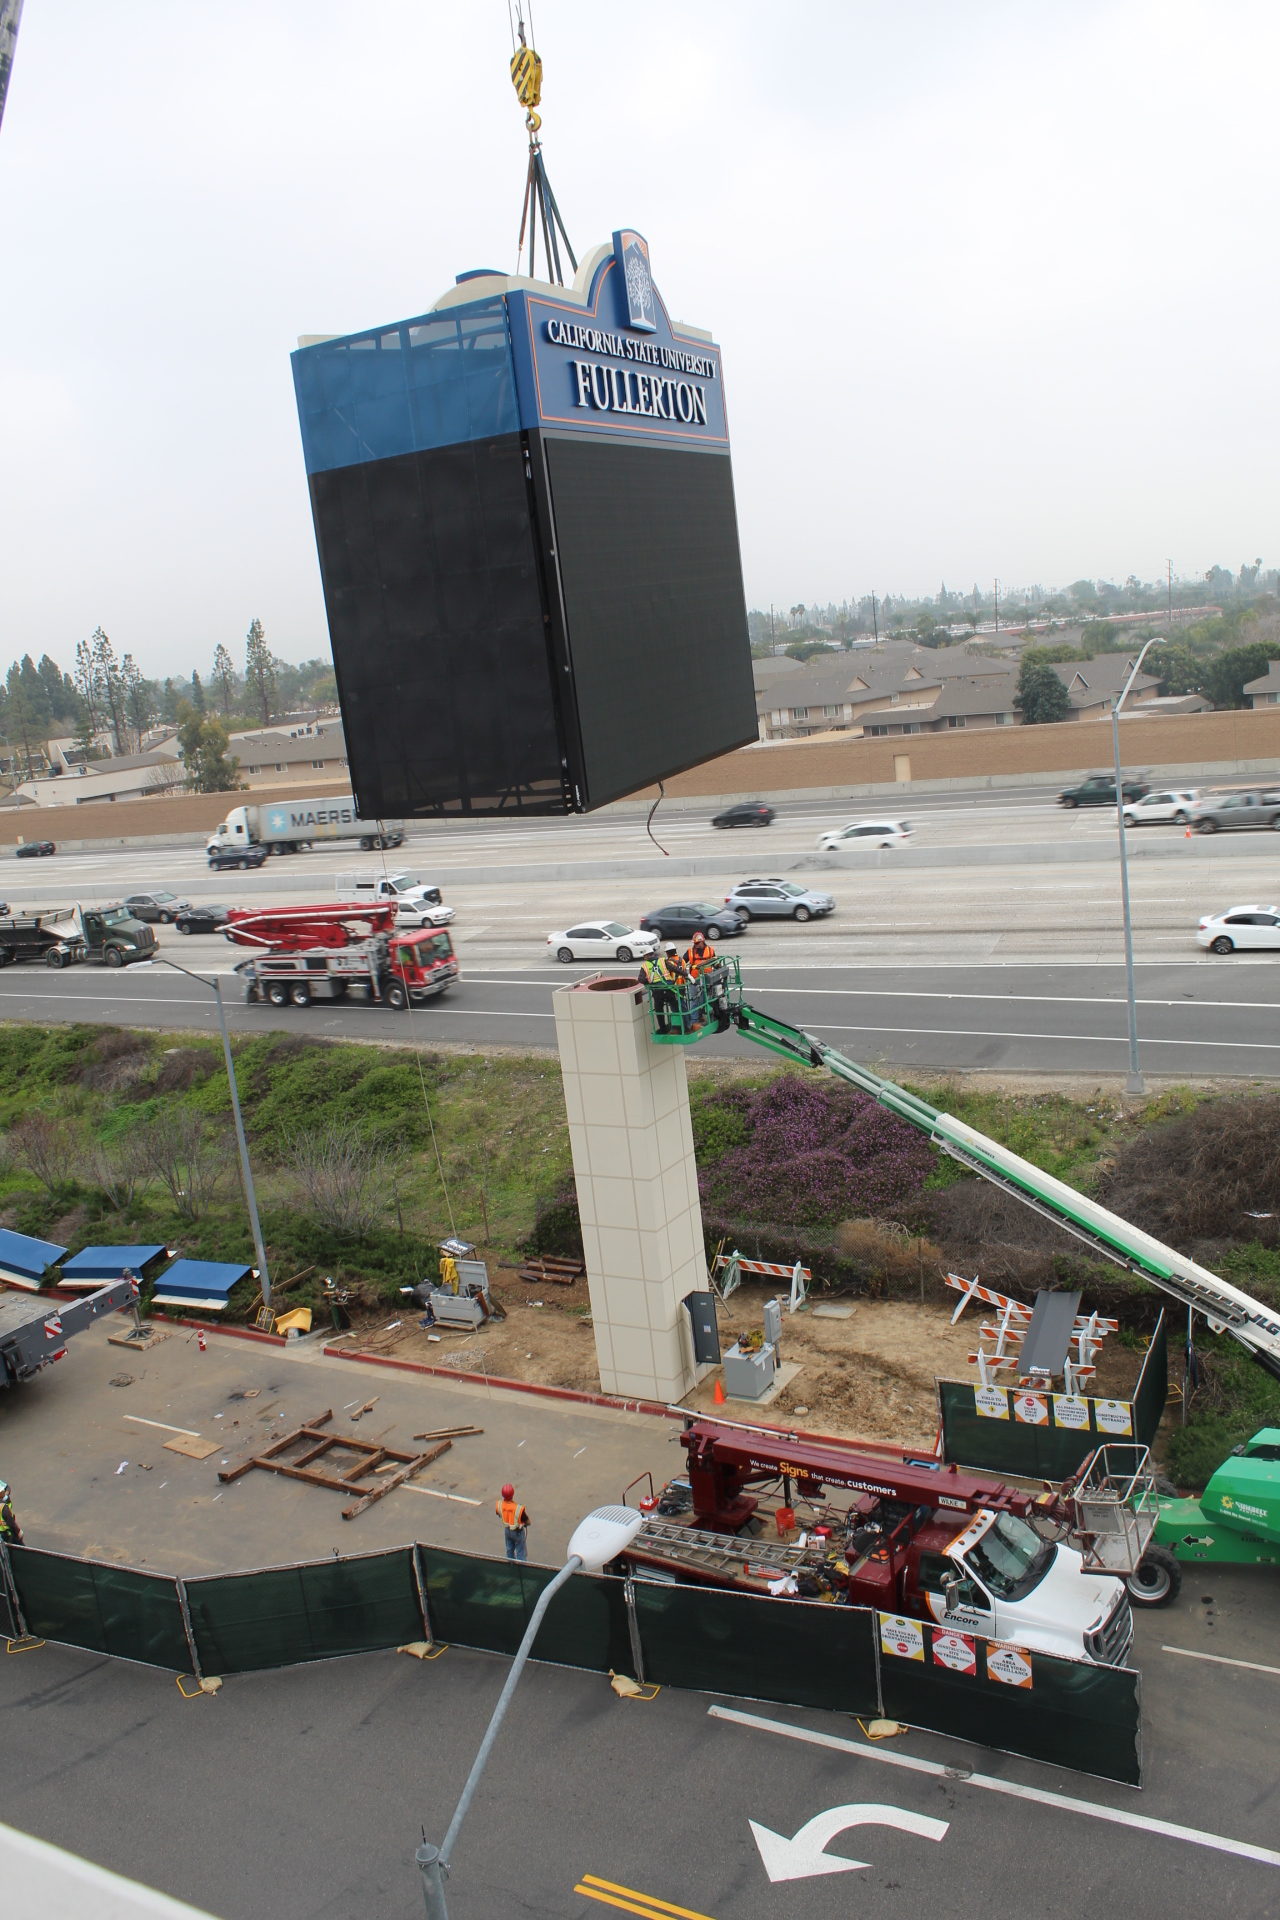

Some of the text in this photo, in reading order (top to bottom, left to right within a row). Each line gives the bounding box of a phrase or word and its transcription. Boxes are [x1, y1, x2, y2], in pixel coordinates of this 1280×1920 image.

[548, 320, 717, 379] CALIFORNIA STATE UNIVERSITY
[573, 360, 708, 425] FULLERTON
[290, 809, 365, 827] MAERS
[1249, 1313, 1280, 1336] JLG
[750, 1459, 760, 1468] We
[760, 1461, 778, 1471] create
[780, 1461, 809, 1478] Signs
[811, 1472, 824, 1481] that
[847, 1479, 897, 1496] customers
[944, 1611, 979, 1626] Encore
[941, 1629, 965, 1640] DANGER
[994, 1642, 1022, 1652] WARNING
[990, 1665, 1028, 1677] SURVEILLANCE
[992, 1661, 1010, 1669] UNDER
